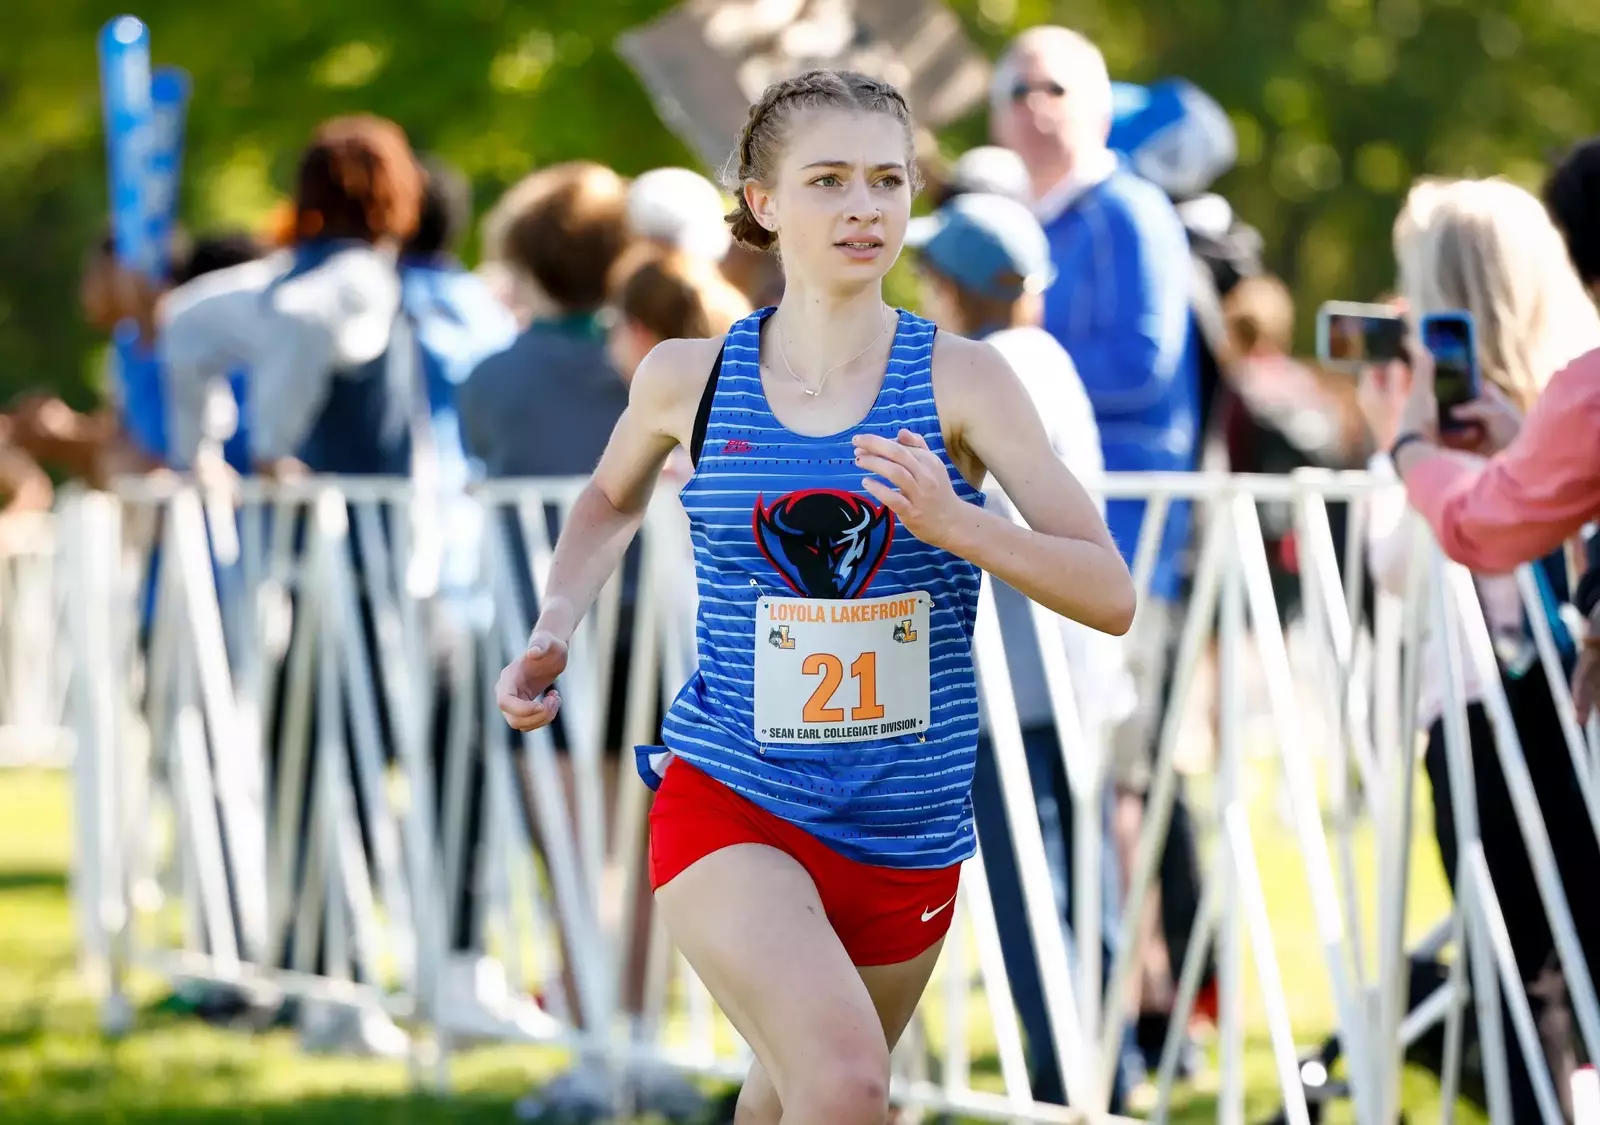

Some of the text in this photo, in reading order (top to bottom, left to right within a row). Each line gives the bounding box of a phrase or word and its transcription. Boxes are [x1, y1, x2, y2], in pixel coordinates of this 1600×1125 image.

[770, 598, 916, 623] LOYOLA LAKEFRONT
[802, 652, 884, 722] 21
[770, 718, 916, 739] SEAN EARL COLLEGIATE DIVISION
